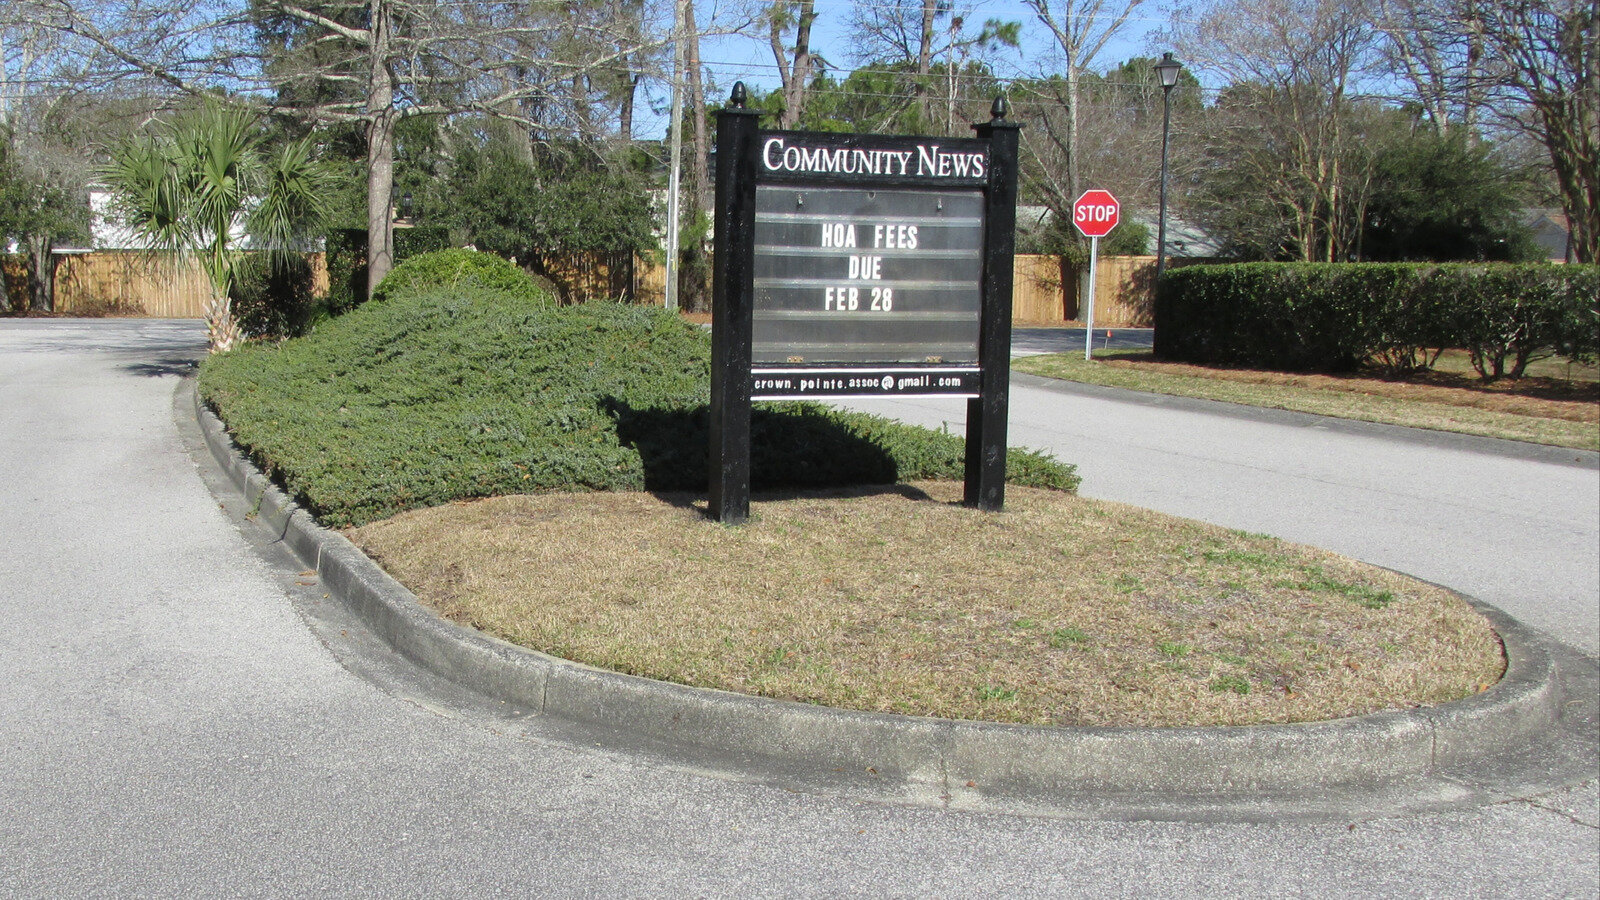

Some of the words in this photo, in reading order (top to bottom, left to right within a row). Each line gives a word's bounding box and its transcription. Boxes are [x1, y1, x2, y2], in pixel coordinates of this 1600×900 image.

[763, 138, 913, 175] COMMUNITY
[917, 145, 985, 178] NEWS
[1076, 205, 1116, 222] STOP
[821, 223, 856, 248] HOA
[874, 225, 918, 249] FEES
[848, 255, 882, 280] DUE
[825, 287, 859, 311] FEB
[870, 287, 893, 312] 28
